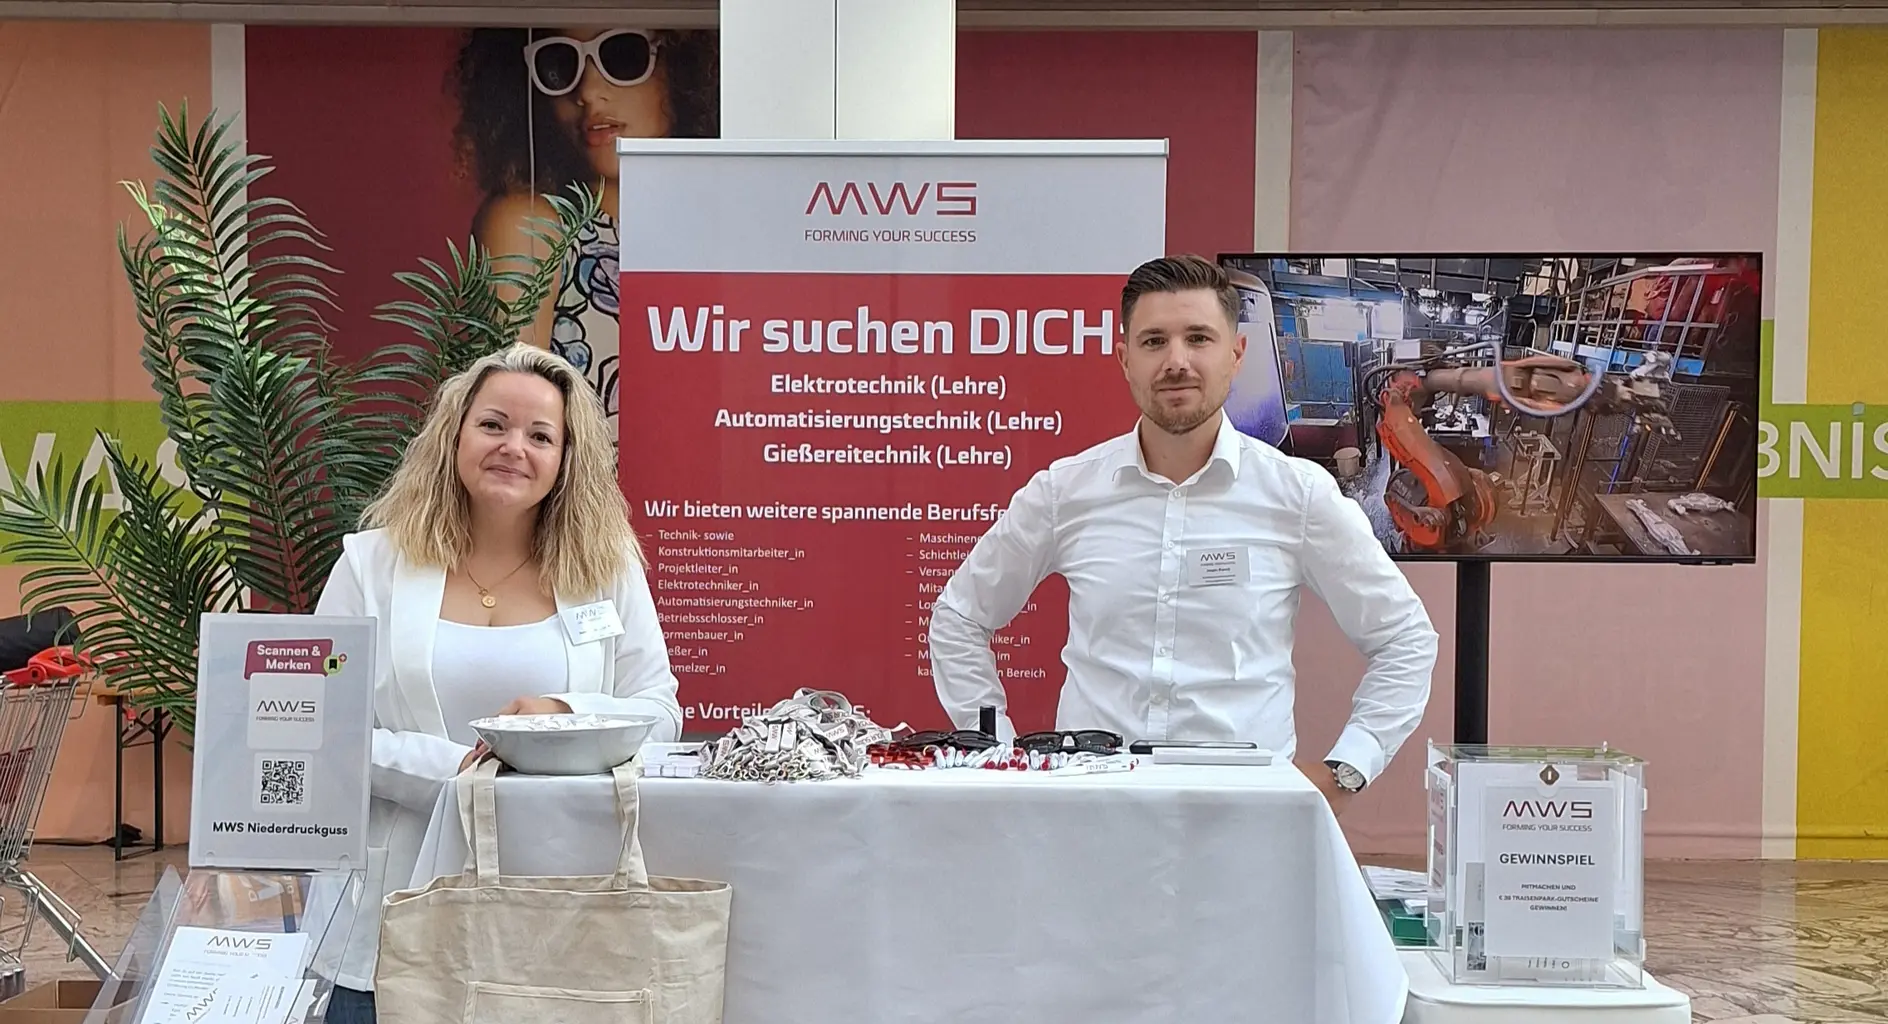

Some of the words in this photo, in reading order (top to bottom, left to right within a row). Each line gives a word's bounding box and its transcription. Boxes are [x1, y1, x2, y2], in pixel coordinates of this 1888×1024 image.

[805, 182, 977, 215] MWS
[805, 230, 868, 242] FORMING
[872, 230, 910, 242] YOUR
[914, 230, 977, 243] SUCCESS
[647, 305, 750, 353] Wir
[763, 305, 953, 354] suchen
[771, 374, 925, 395] Elektrotechnik
[931, 375, 1006, 399] (Lehre)
[715, 409, 981, 433] Automatisierungstechnik
[987, 410, 1062, 435] (Lehre)
[763, 444, 931, 465] Gießereitechnik
[936, 445, 1012, 470] (Lehre)
[644, 500, 679, 518] Wir
[684, 500, 741, 518] bieten
[747, 501, 817, 519] weitere
[822, 503, 922, 523] spannende
[658, 530, 701, 540] Technik-
[704, 531, 734, 541] sowie
[658, 546, 805, 560] Konstruktionsmitarbeiter_in
[1201, 552, 1235, 561] MWS
[658, 563, 738, 576] Projektleiter_in
[919, 566, 956, 577] Versan
[658, 580, 759, 593] Elektrotechniker_in
[657, 597, 814, 611] Automatisierungstechniker_in
[663, 629, 744, 643] ormenbauer_in
[257, 644, 308, 656] Scannen
[312, 645, 321, 656] &
[668, 645, 708, 659] eßer_in
[265, 659, 311, 671] Merken
[1006, 667, 1046, 679] Bereich
[256, 700, 316, 713] MWS
[1503, 800, 1592, 818] MWS
[212, 822, 244, 833] MWS
[248, 823, 348, 837] Niederdruckguss
[1499, 853, 1595, 866] GEWINNSPIEL
[207, 935, 272, 949] MWS
